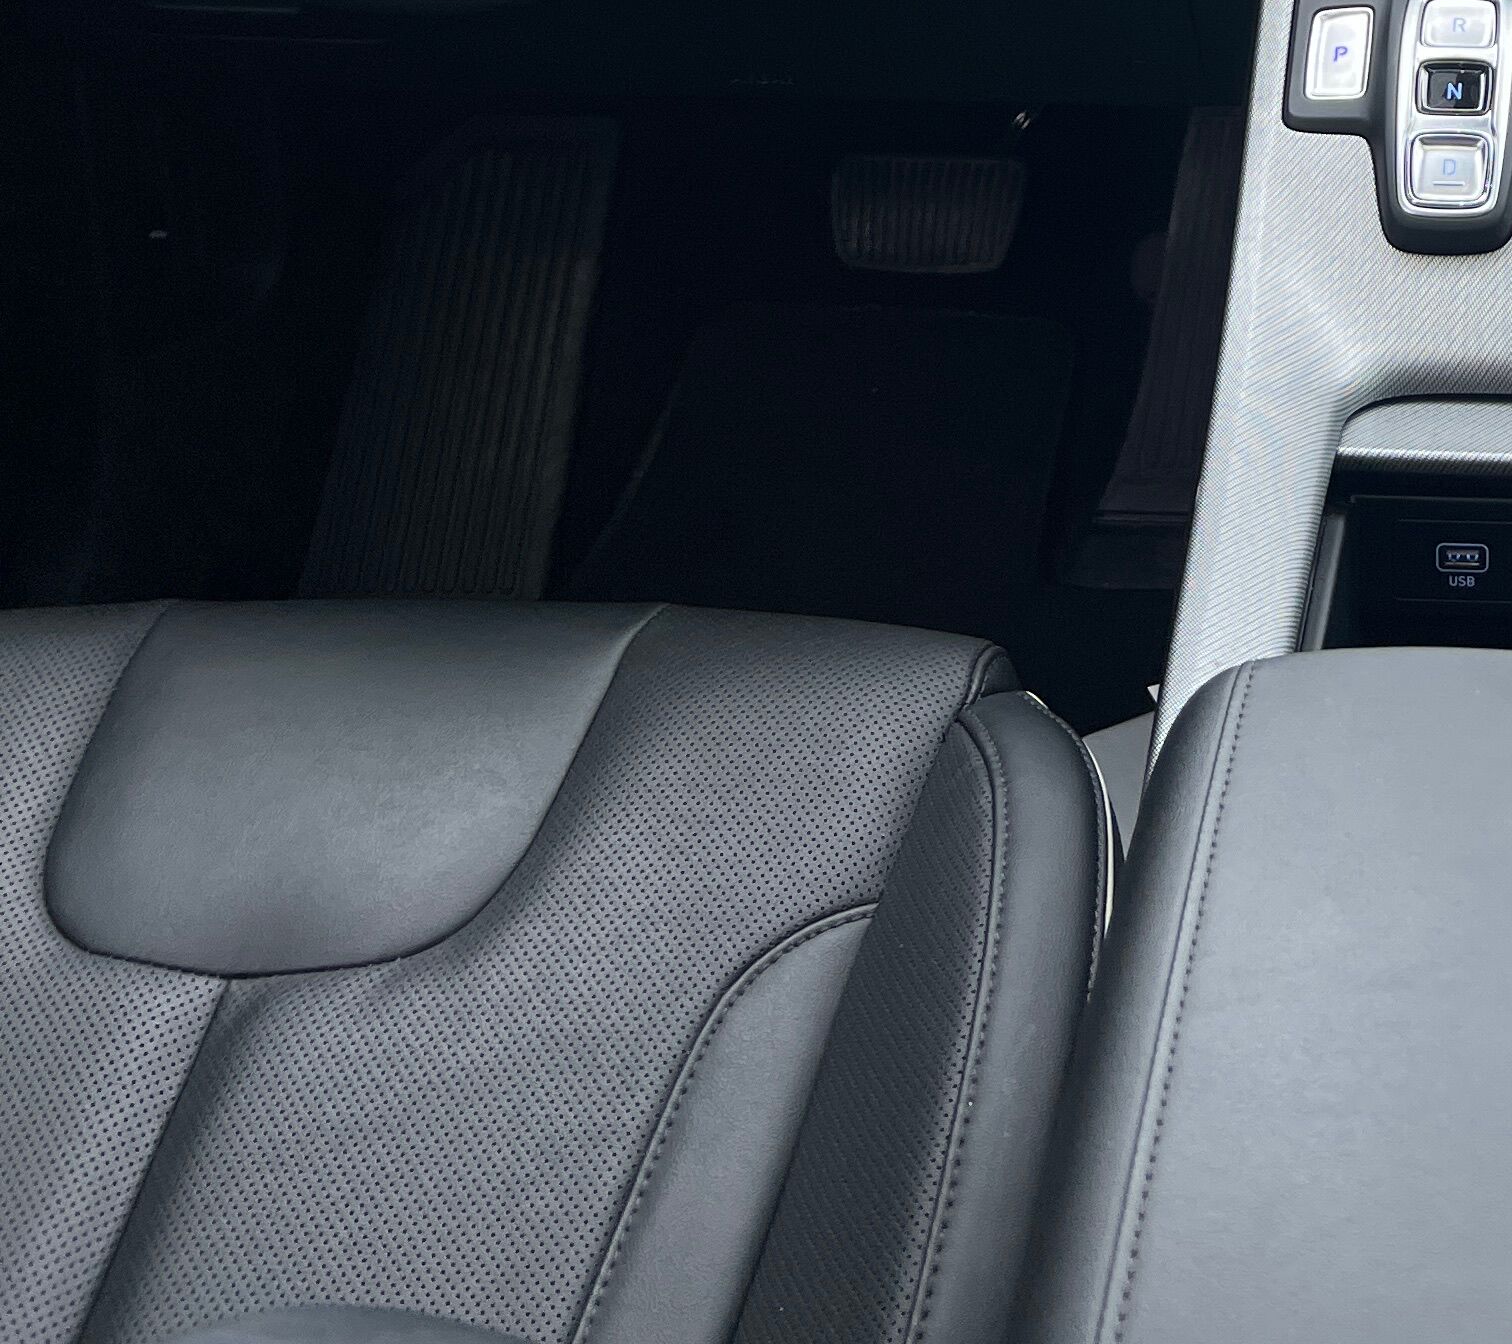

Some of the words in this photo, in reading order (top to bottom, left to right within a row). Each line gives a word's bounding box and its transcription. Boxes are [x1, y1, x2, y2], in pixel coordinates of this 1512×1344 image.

[1452, 17, 1466, 32] R
[1333, 46, 1348, 62] P
[1446, 82, 1463, 99] N
[1443, 159, 1456, 175] D
[1448, 576, 1476, 587] USB
